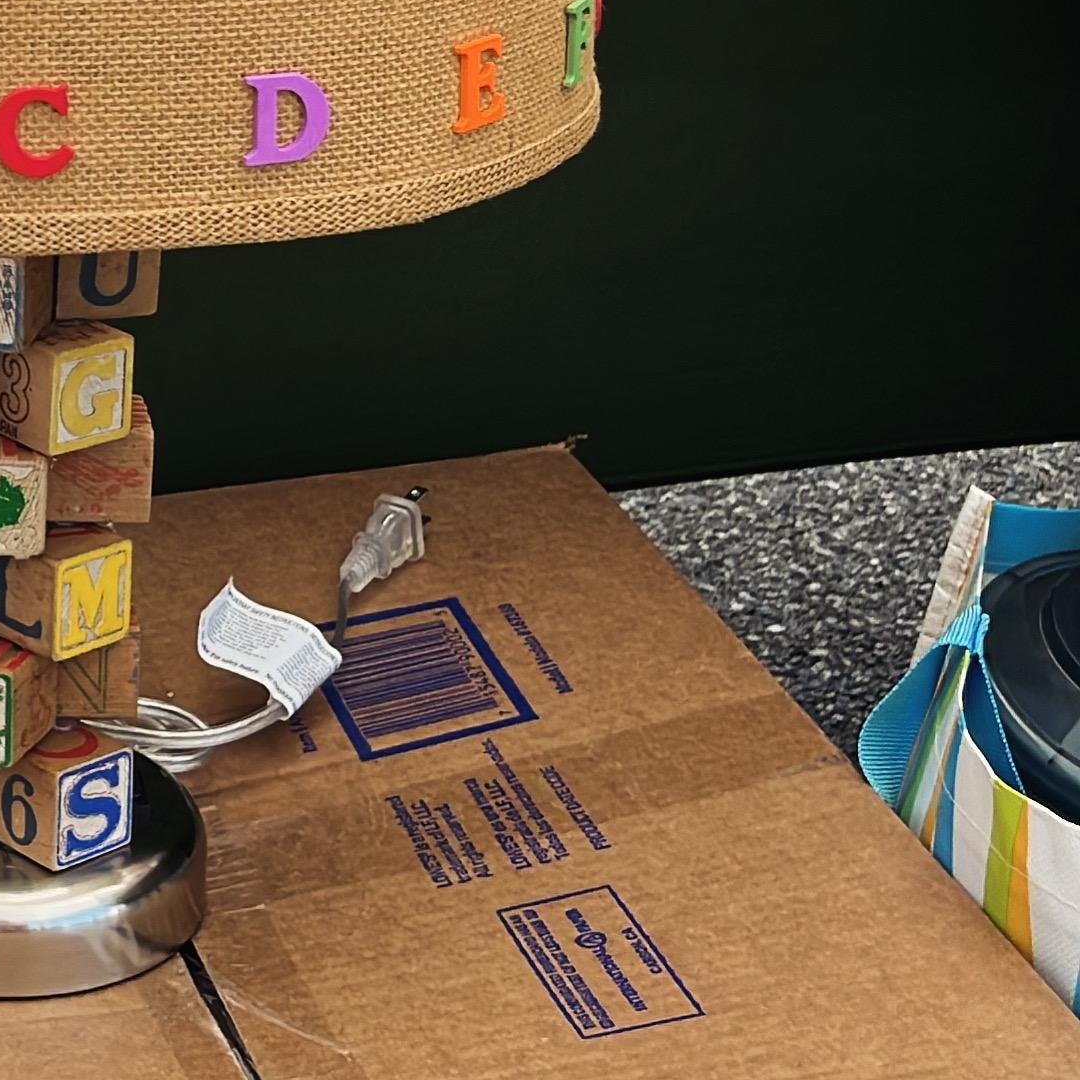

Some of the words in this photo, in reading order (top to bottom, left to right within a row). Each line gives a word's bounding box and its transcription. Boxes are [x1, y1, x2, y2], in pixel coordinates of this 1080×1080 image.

[243, 72, 333, 167] D
[452, 33, 506, 133] E
[0, 352, 31, 424] 3
[60, 355, 124, 438] G
[63, 556, 124, 642] M
[1, 773, 37, 846] 6
[66, 761, 122, 857] S
[540, 765, 566, 790] CODE
[569, 810, 612, 850] PRODUCT
